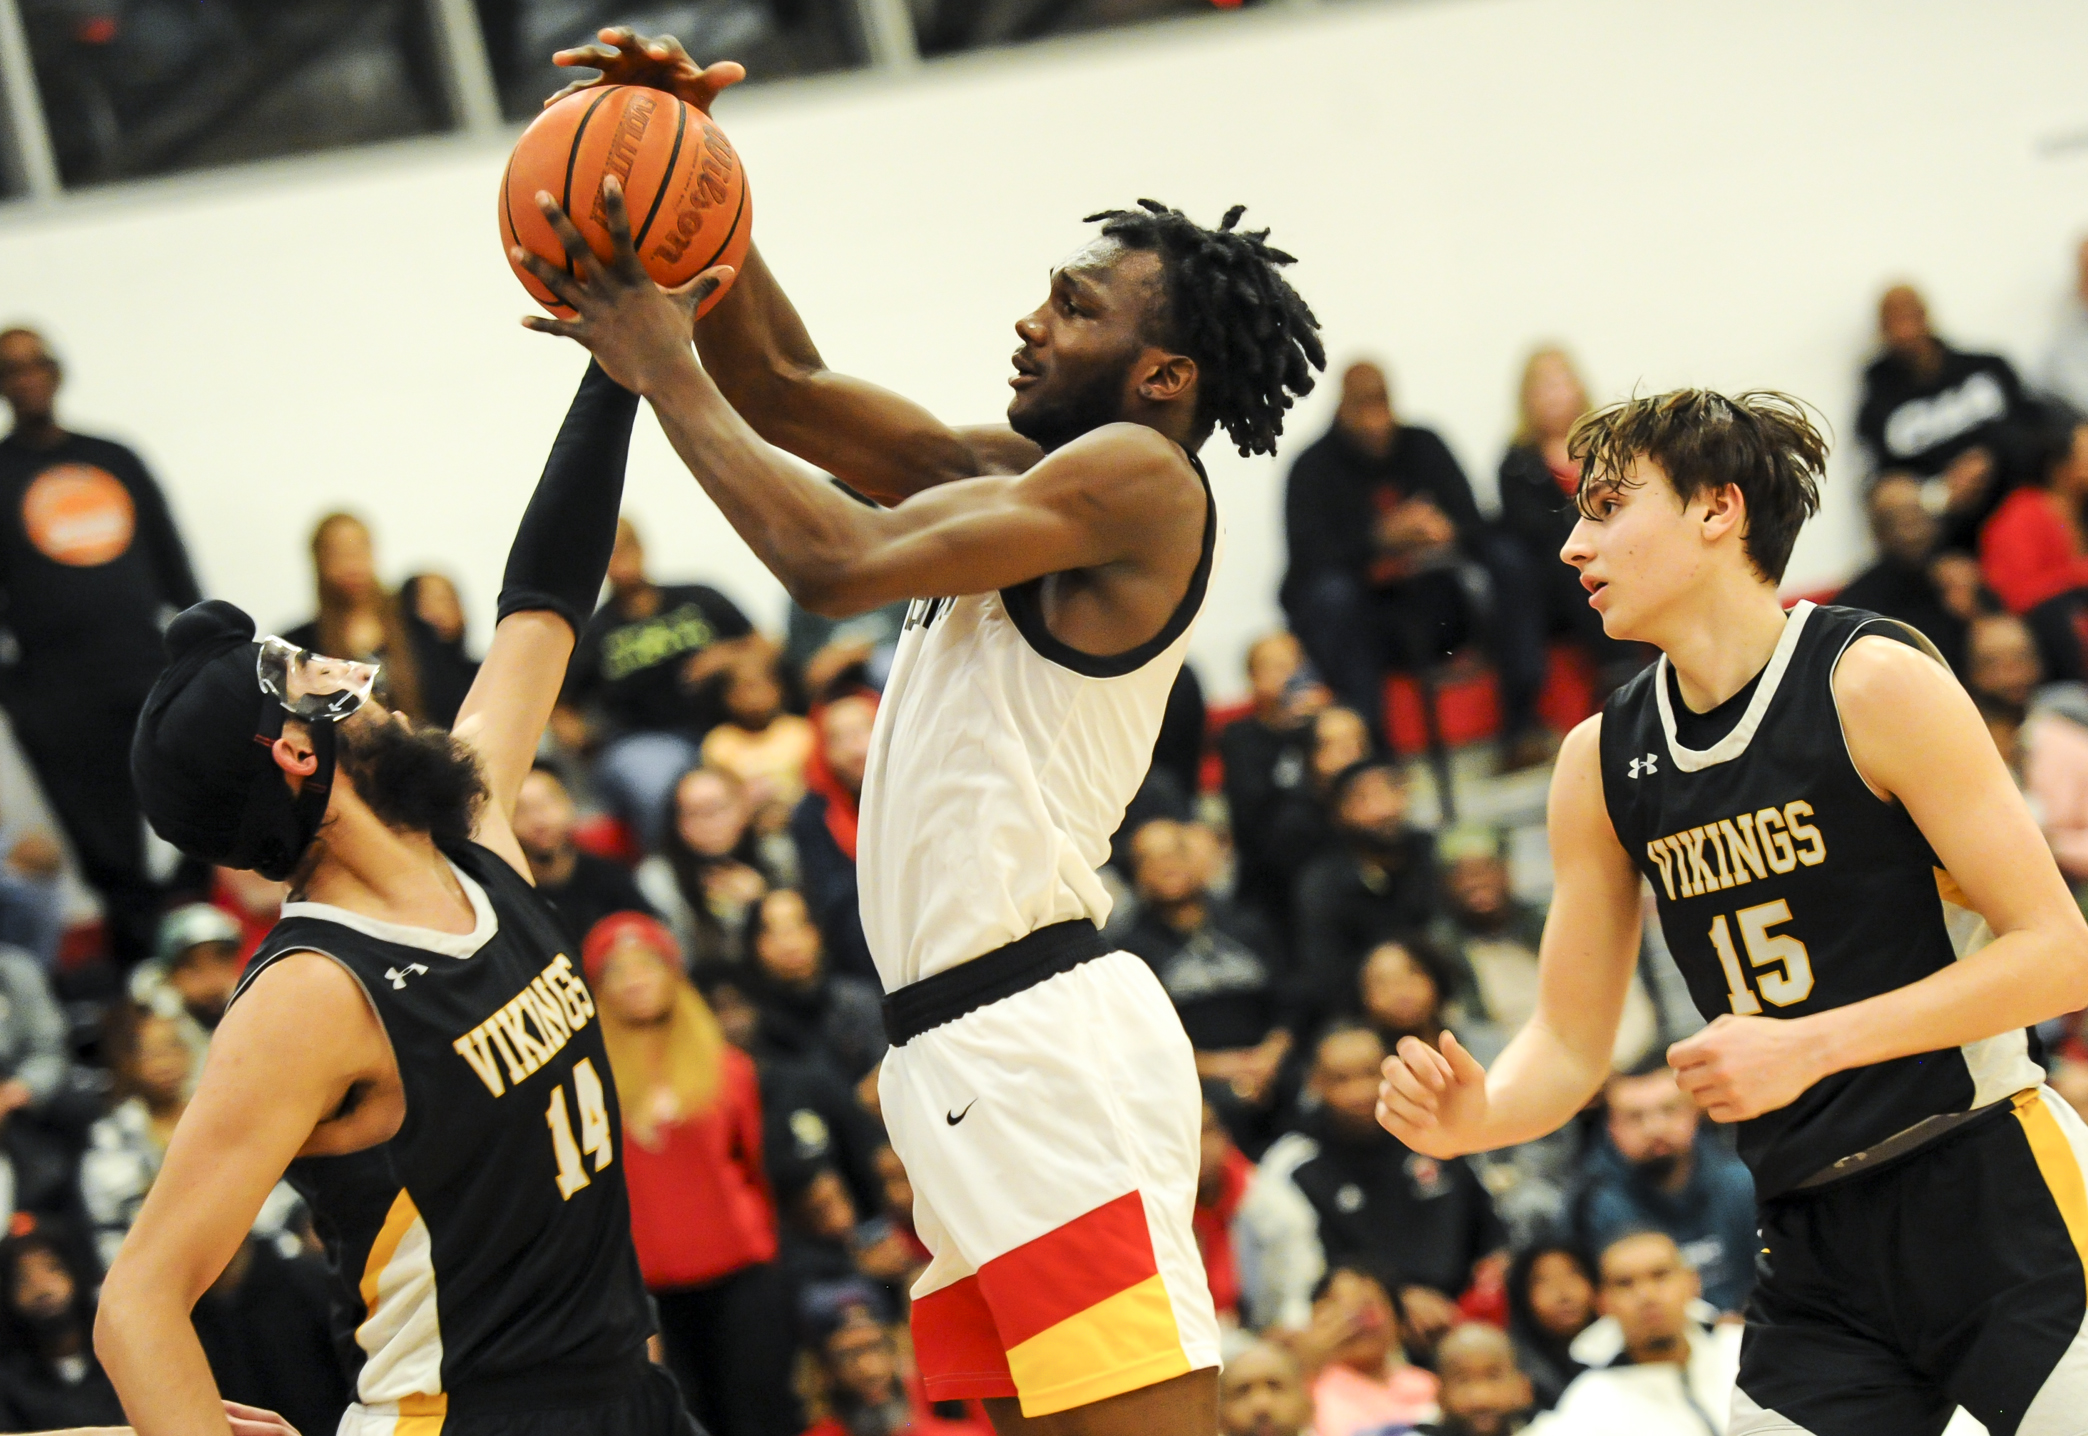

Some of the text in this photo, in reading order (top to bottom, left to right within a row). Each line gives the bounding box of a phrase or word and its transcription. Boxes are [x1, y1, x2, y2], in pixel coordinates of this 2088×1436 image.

[653, 122, 733, 265] Wilson
[1647, 800, 1827, 901] VIKINGS
[452, 952, 596, 1098] VIKINGS
[1708, 898, 1815, 1016] 15
[545, 1057, 612, 1202] 14
